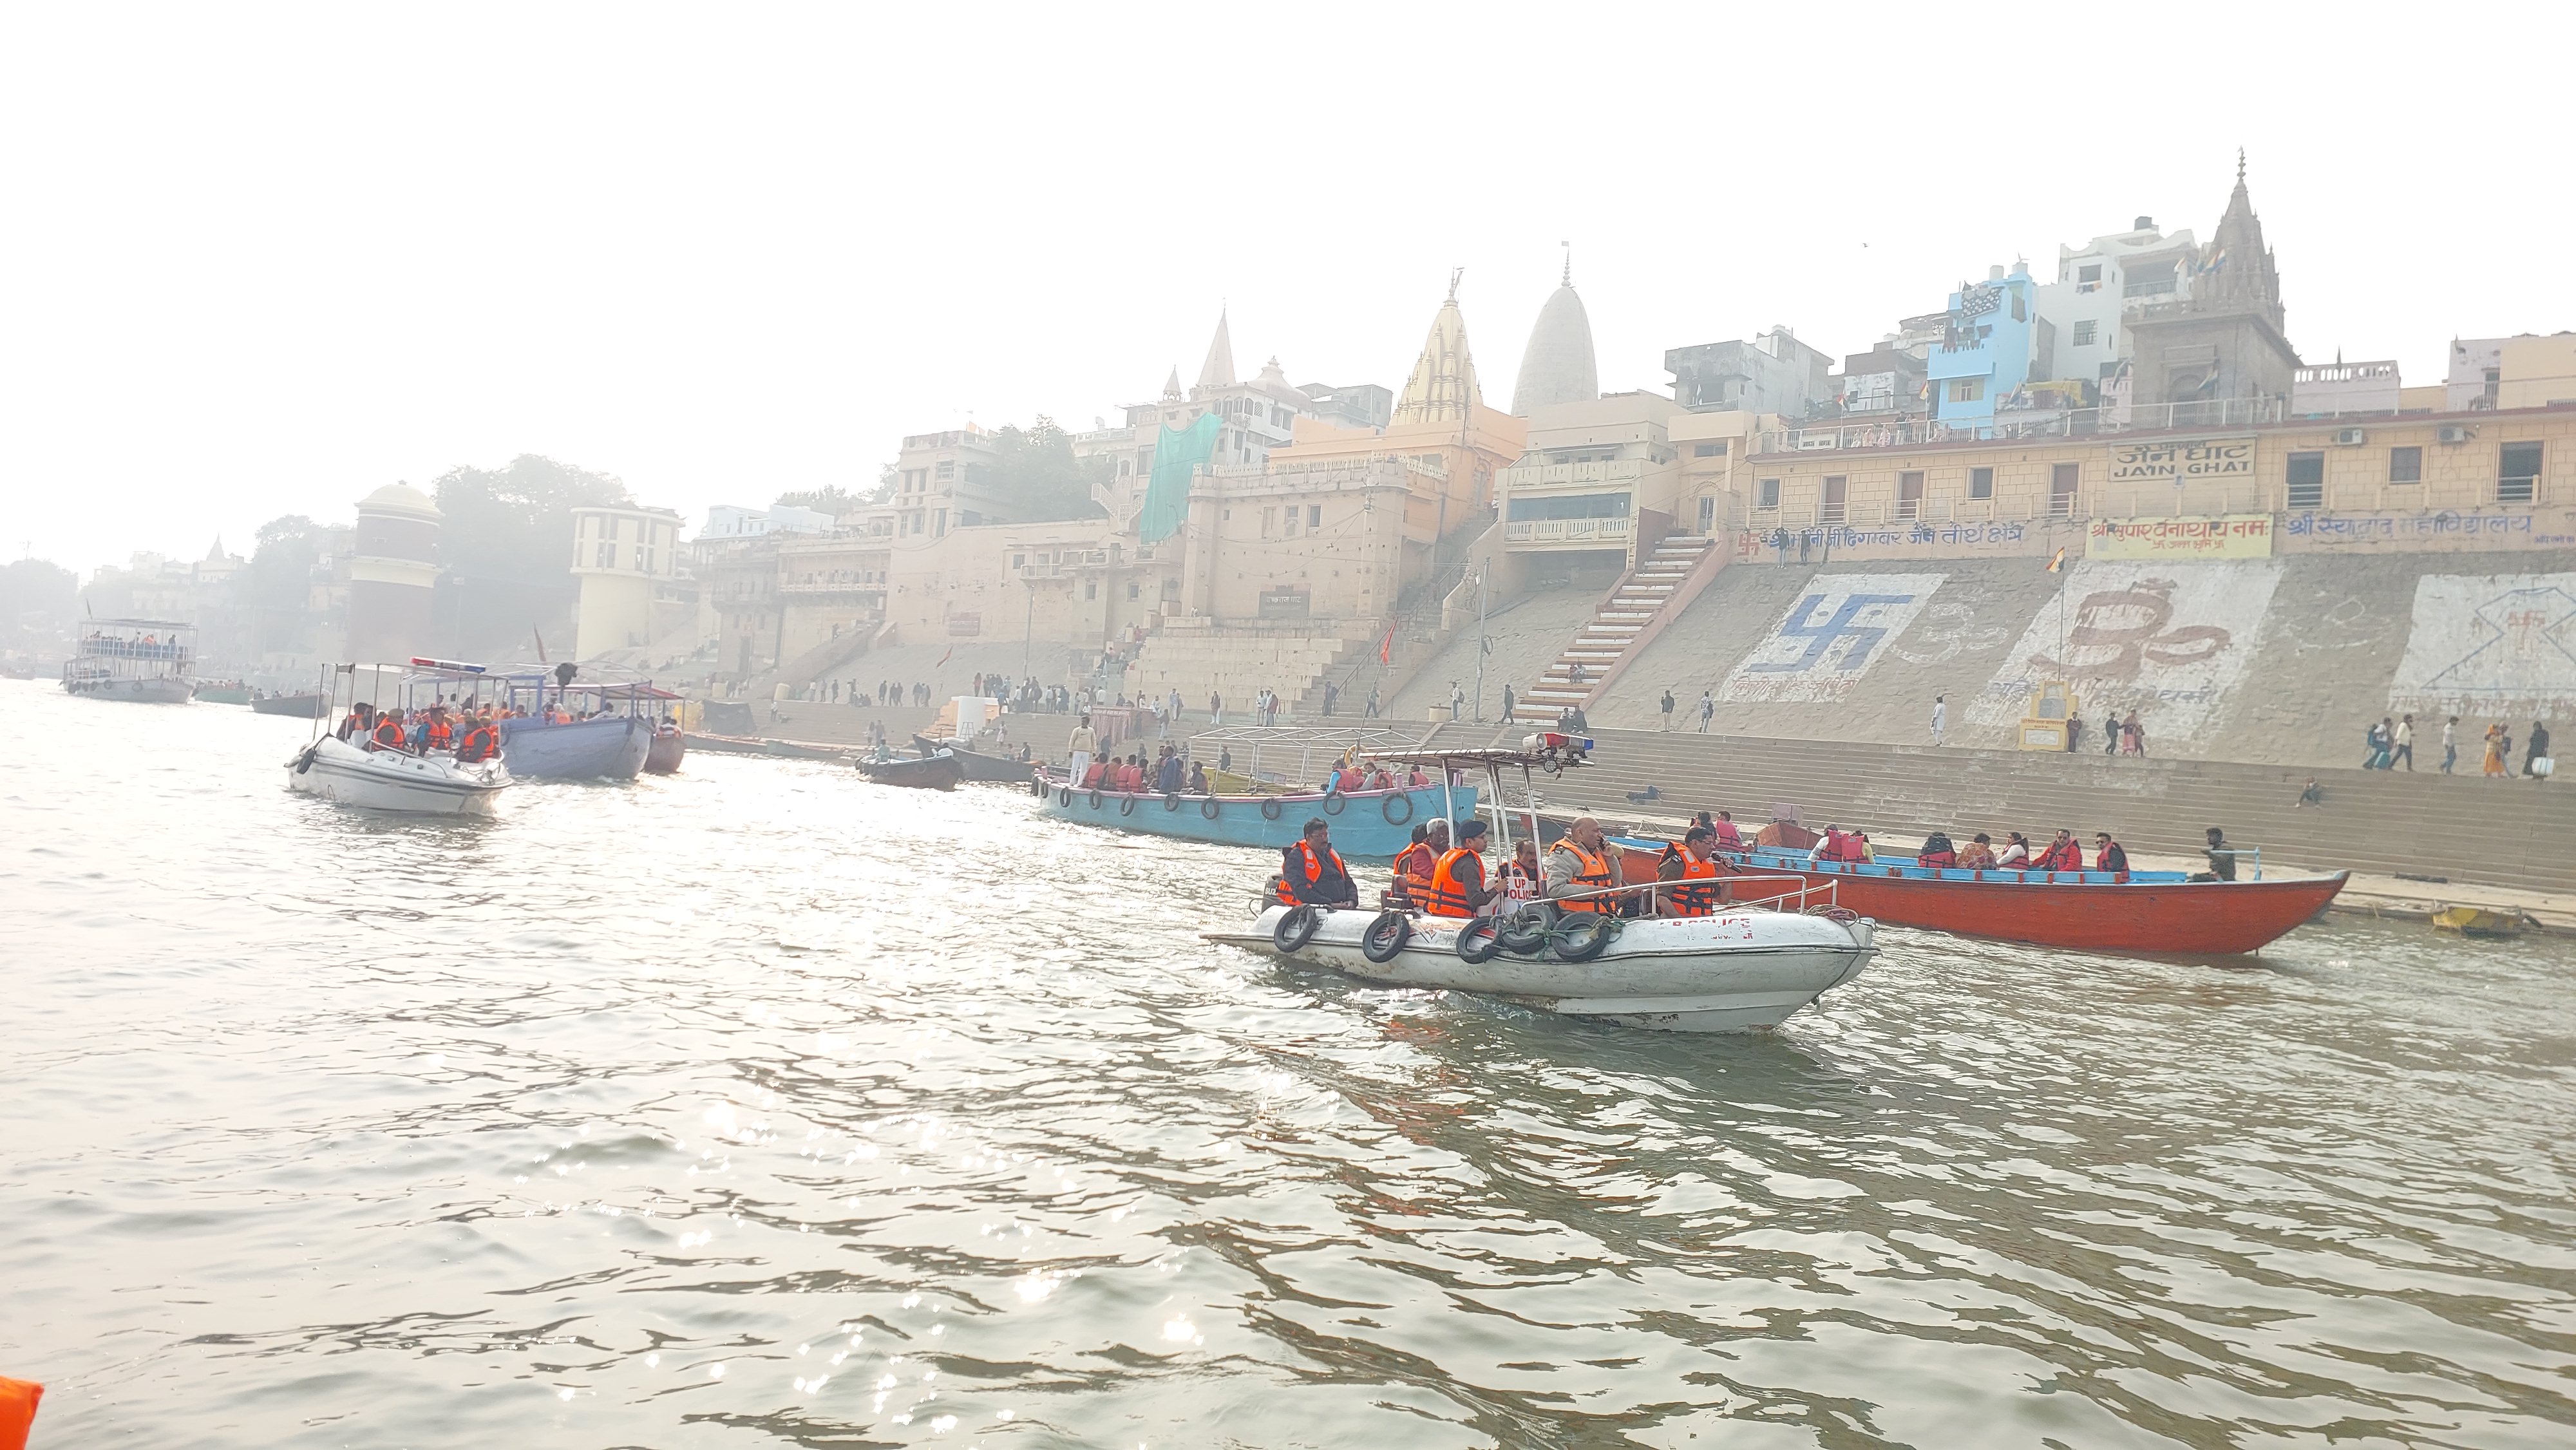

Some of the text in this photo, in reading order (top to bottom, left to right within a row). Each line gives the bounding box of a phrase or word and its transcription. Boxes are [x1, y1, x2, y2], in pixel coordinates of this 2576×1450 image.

[2117, 444, 2176, 464] जैन
[2184, 445, 2251, 461] घाट
[2114, 461, 2249, 478] JAIN GHAT
[2233, 520, 2269, 538] नमः
[2287, 511, 2313, 536] श्री
[1514, 878, 1526, 889] UP
[1509, 889, 1531, 900] OLIC
